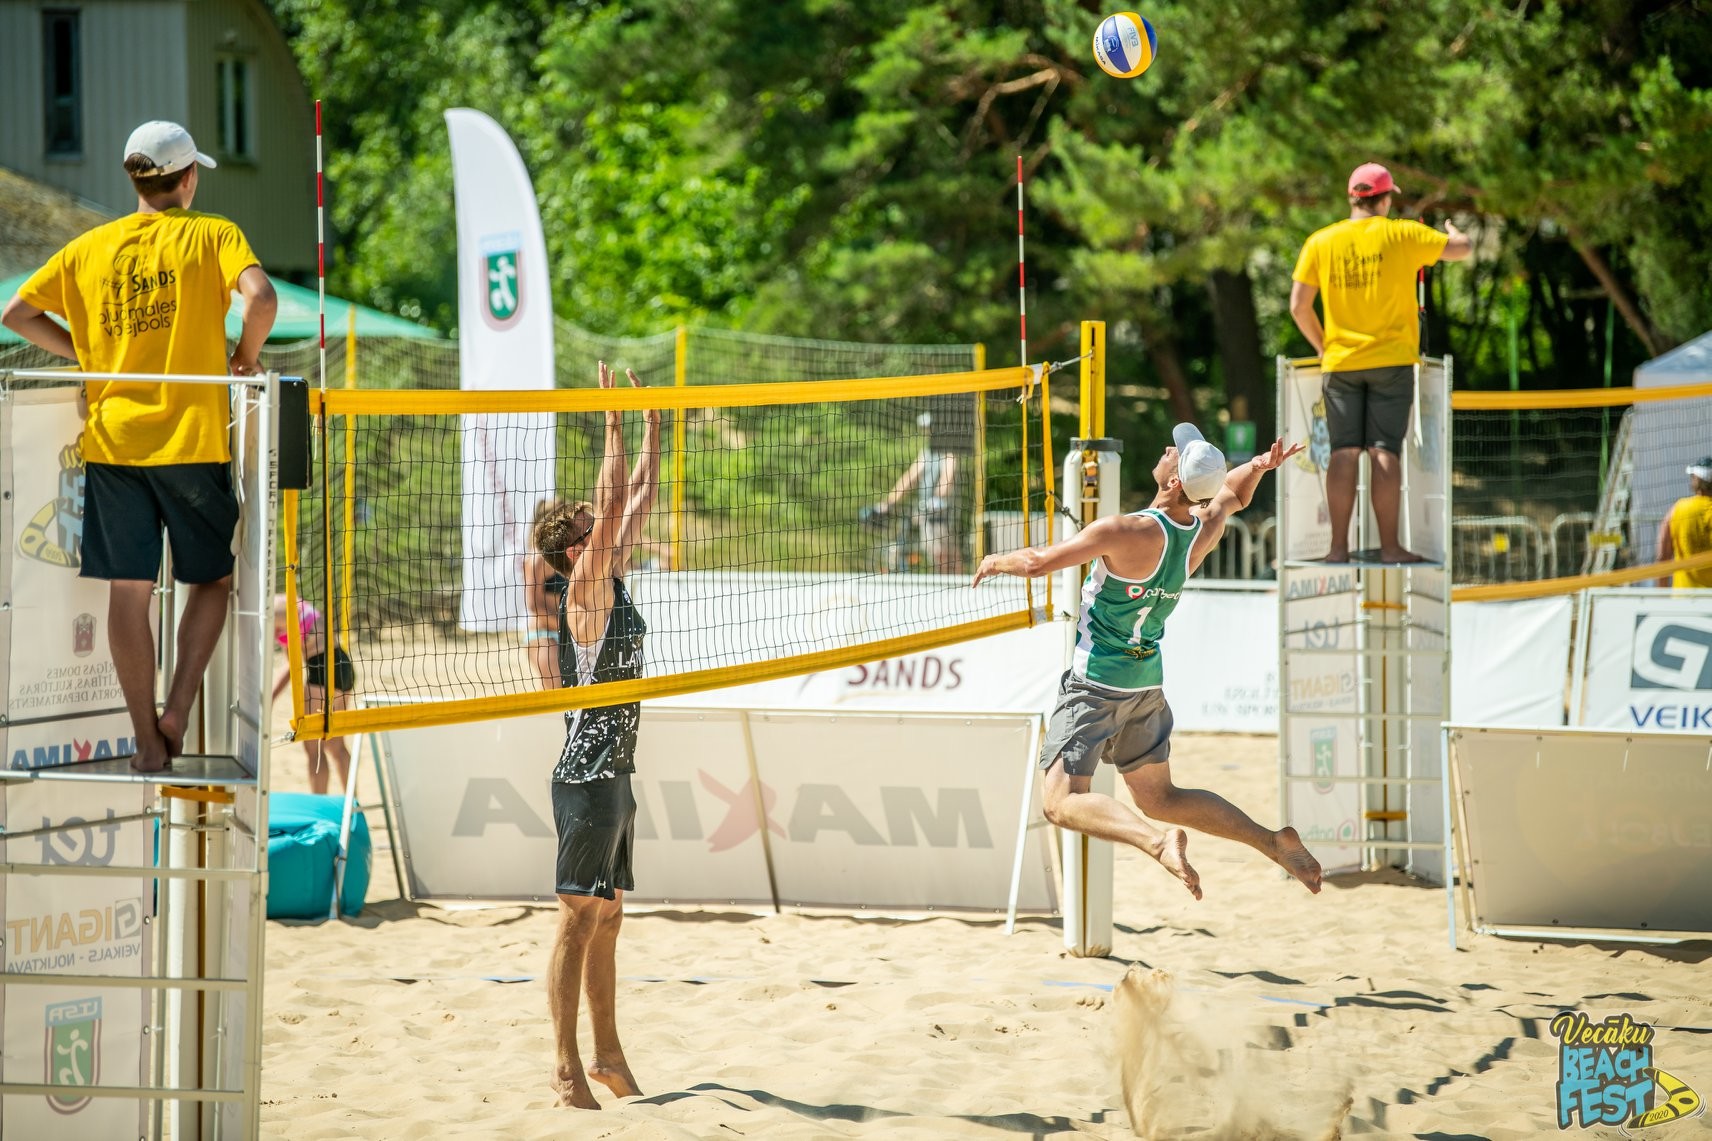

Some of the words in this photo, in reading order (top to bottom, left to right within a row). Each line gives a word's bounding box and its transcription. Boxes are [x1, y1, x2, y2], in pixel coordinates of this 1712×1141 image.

[131, 269, 176, 293] SANDS
[1127, 606, 1153, 645] 1
[848, 656, 964, 690] SANDS
